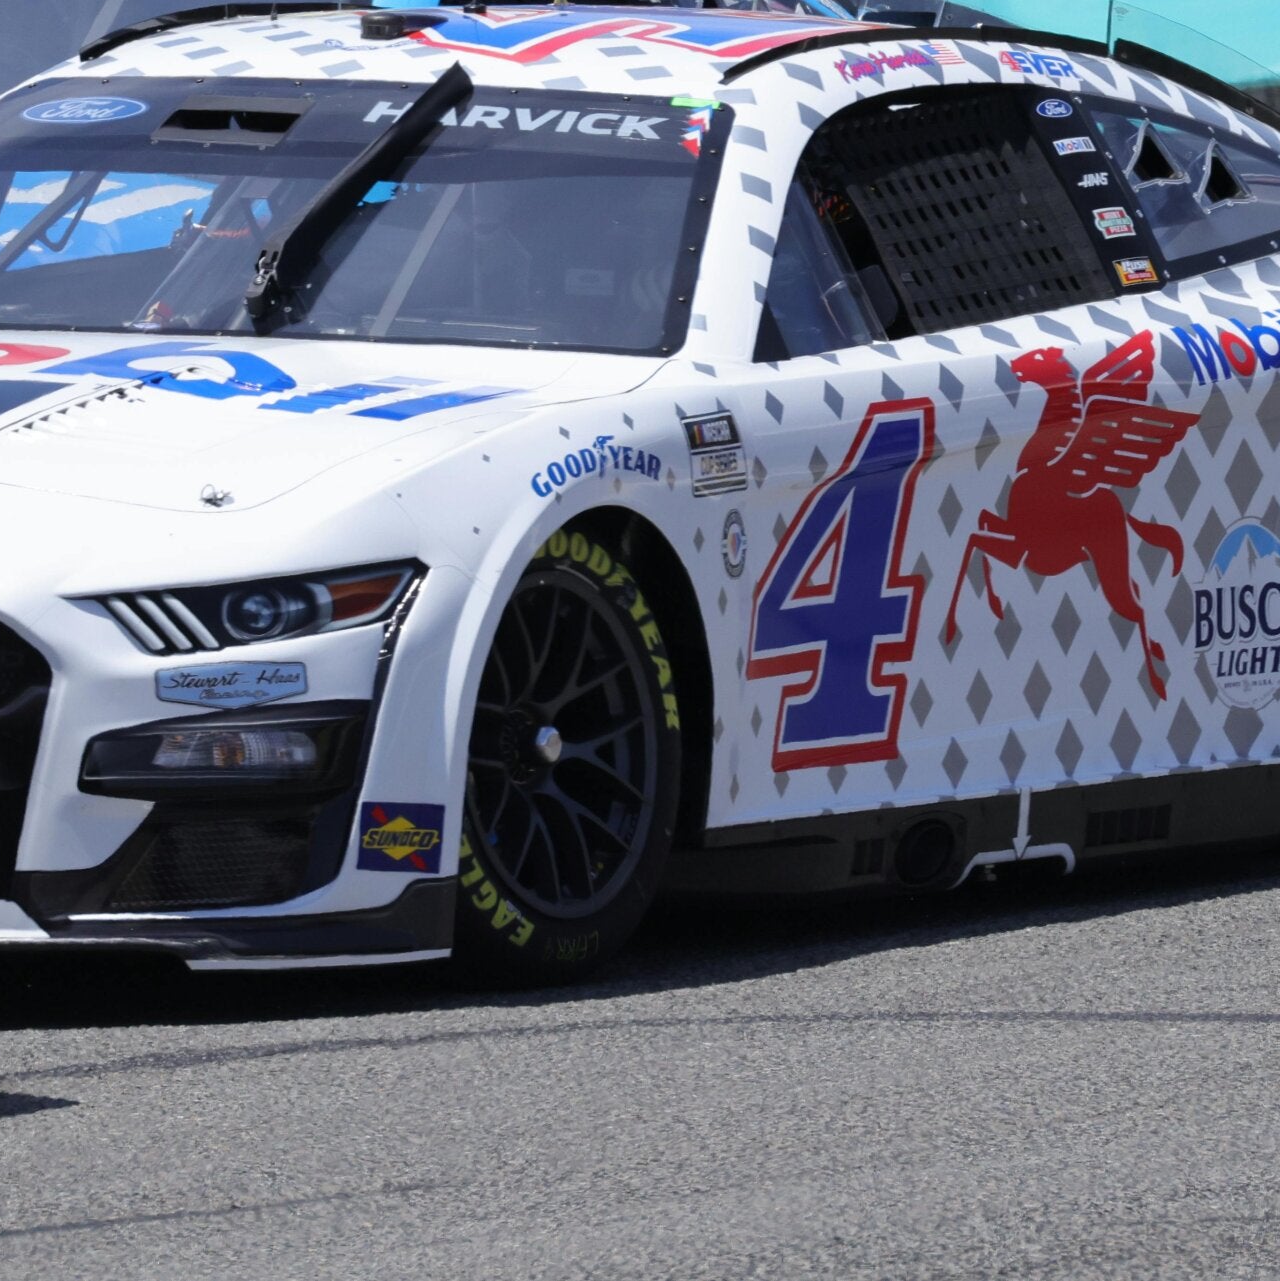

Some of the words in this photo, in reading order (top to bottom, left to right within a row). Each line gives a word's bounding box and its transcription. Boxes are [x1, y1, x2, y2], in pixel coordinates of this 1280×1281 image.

[999, 50, 1082, 79] 4EVER
[44, 100, 126, 121] Ford
[363, 101, 668, 140] HARVICK
[1056, 141, 1084, 153] Mobil
[530, 435, 662, 498] GOODYEAR
[746, 397, 935, 773] 4
[365, 828, 437, 850] SUNOCO
